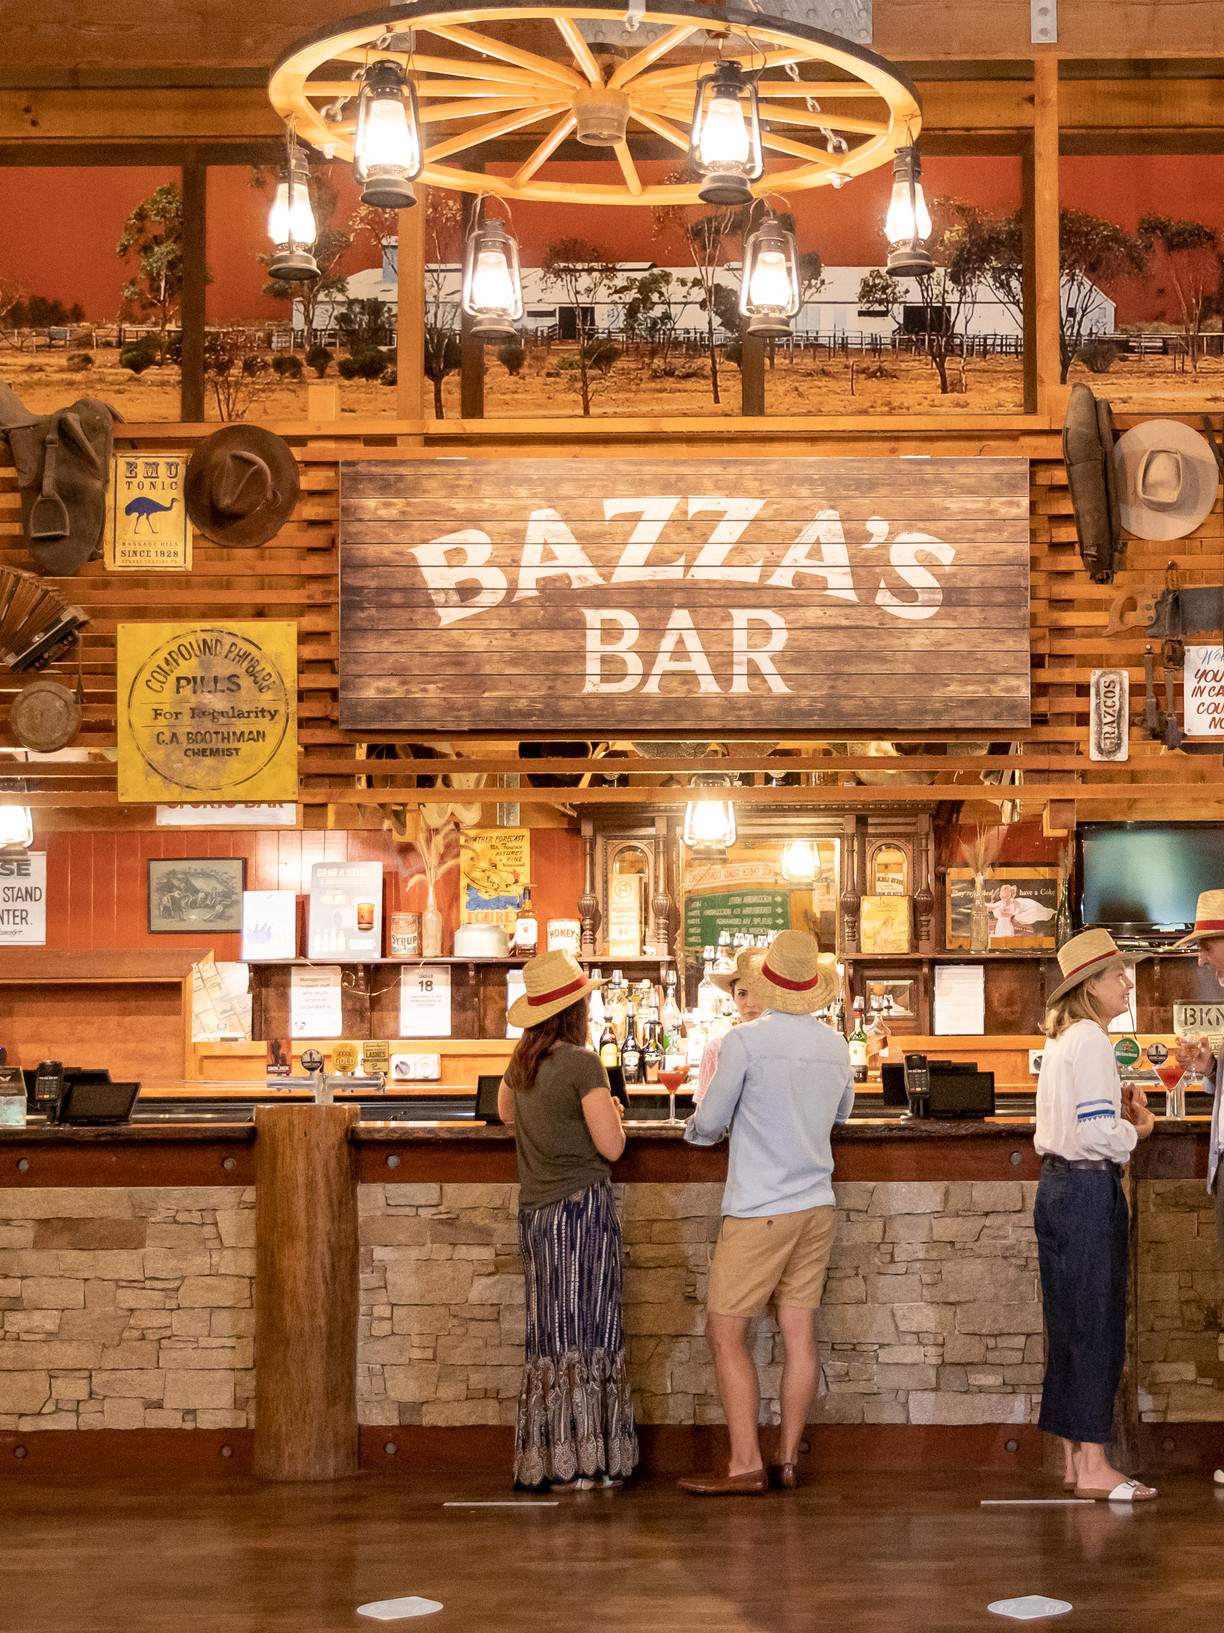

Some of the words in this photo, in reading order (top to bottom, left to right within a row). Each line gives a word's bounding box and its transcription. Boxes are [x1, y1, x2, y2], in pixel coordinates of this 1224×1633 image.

[125, 462, 179, 479] EMU
[126, 481, 178, 490] TONIC
[121, 550, 152, 558] SINCE
[155, 550, 179, 558] 1928
[407, 495, 956, 626] BAZZA'S
[581, 608, 795, 694] BAR
[145, 638, 223, 694] COMPOUND
[175, 673, 242, 695] PILLS
[1191, 685, 1206, 698] IN
[152, 708, 183, 721] For
[190, 706, 280, 723] Regularity
[186, 730, 266, 745] BOOTHMAN
[184, 747, 241, 758] CHEMIST
[464, 835, 493, 843] ATHER
[3, 886, 43, 902] STAND
[392, 933, 417, 949] SYRUP
[550, 928, 576, 939] HONEY
[418, 980, 434, 992] 18
[333, 1057, 355, 1065] GOLD
